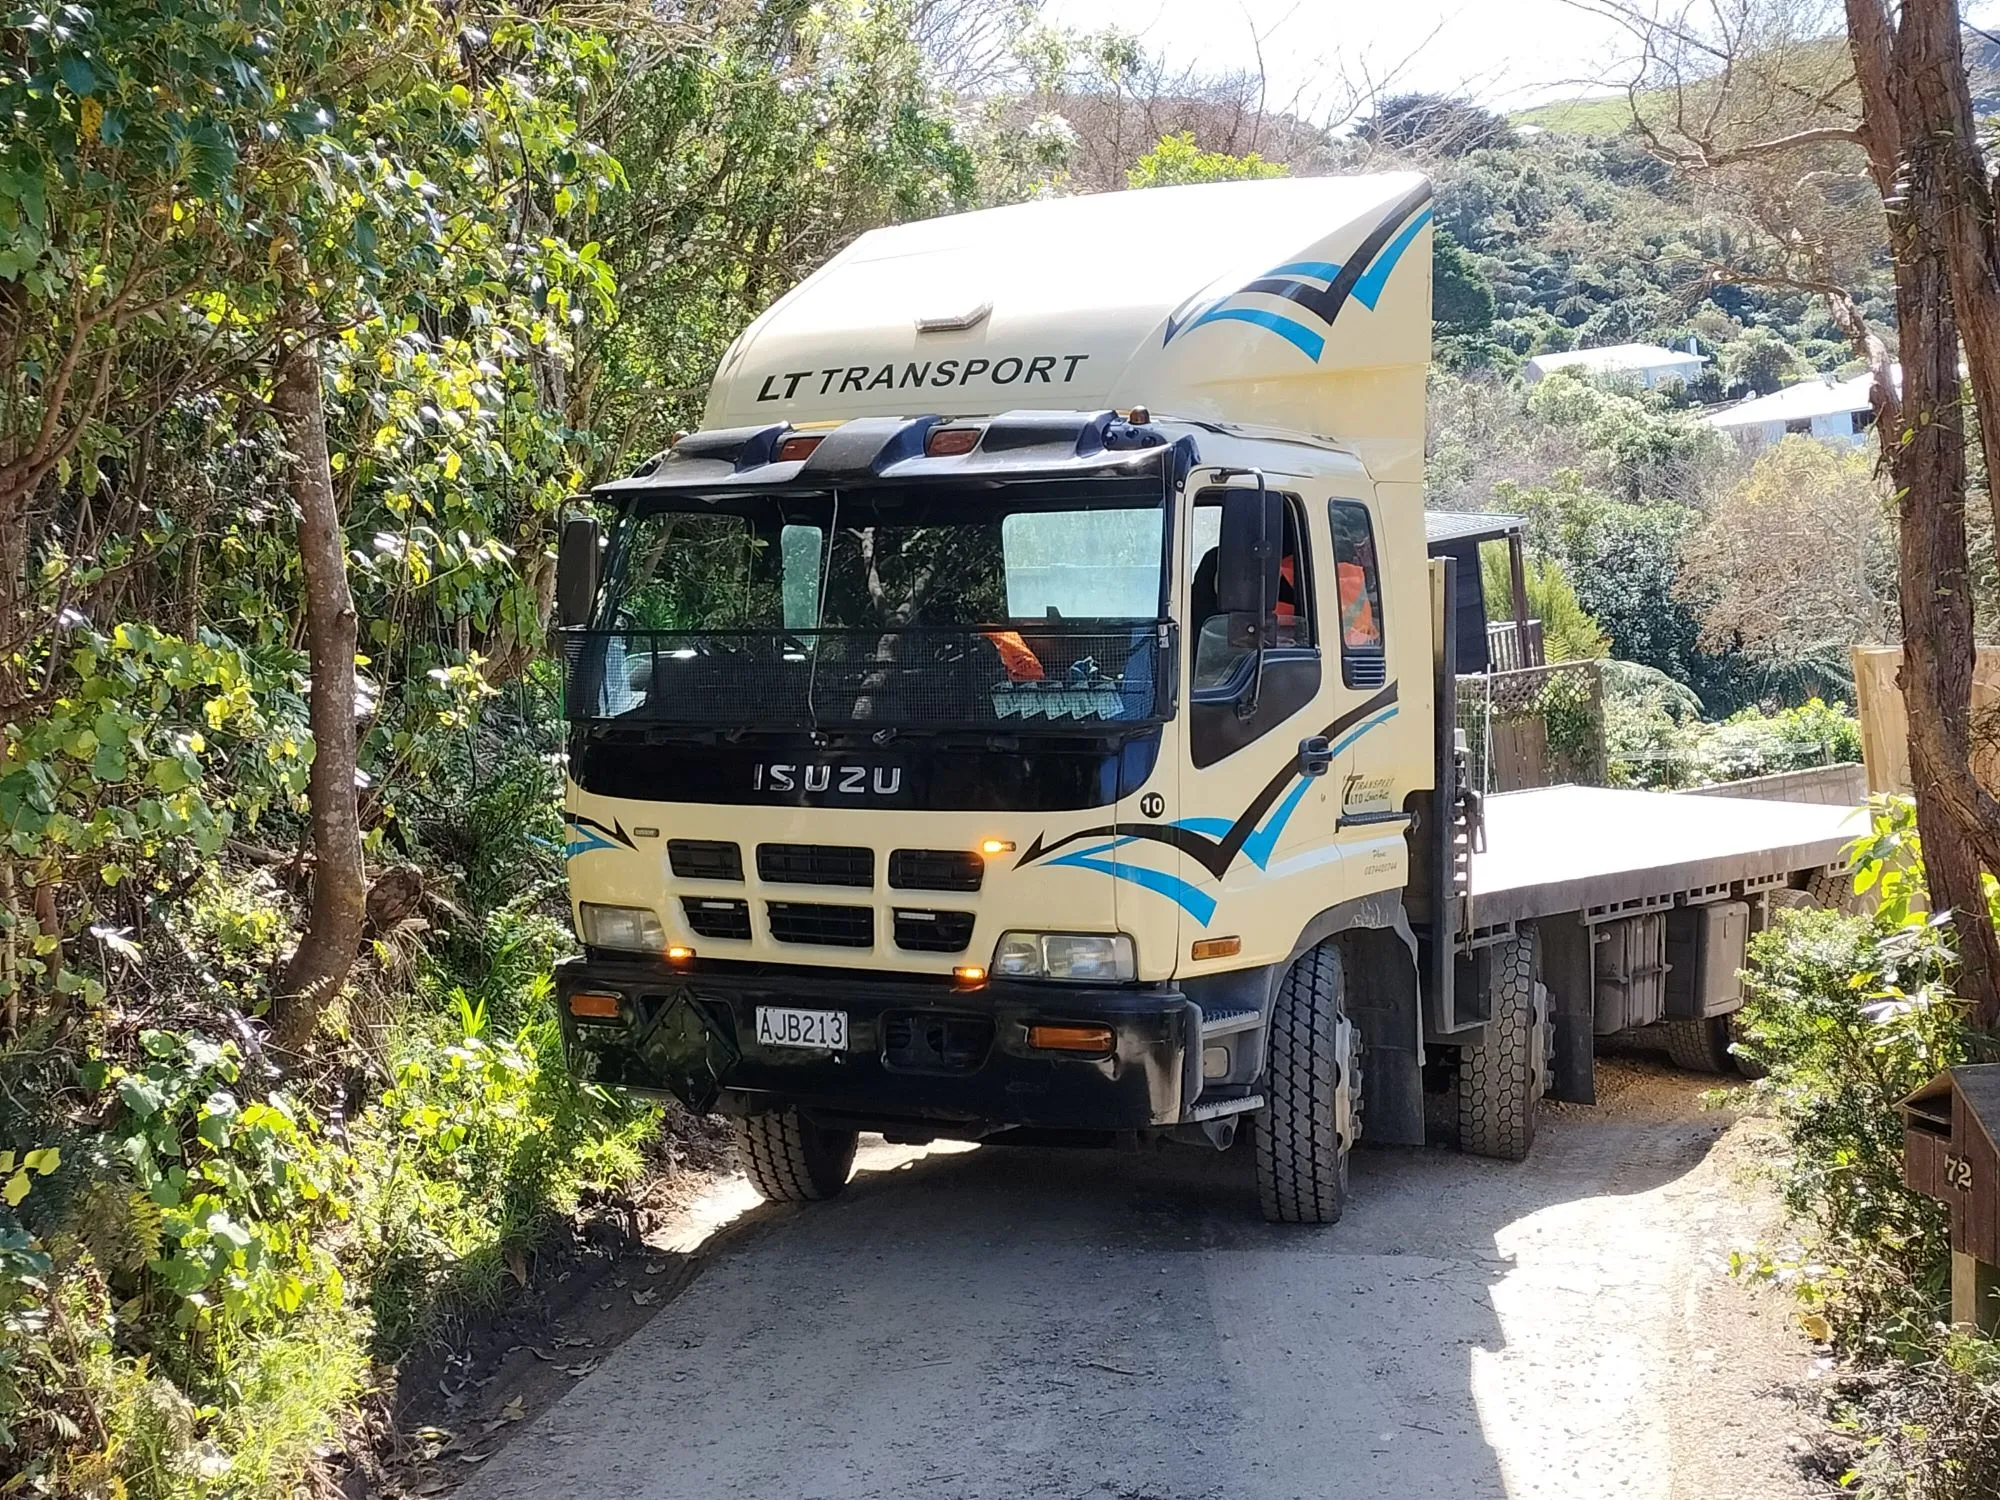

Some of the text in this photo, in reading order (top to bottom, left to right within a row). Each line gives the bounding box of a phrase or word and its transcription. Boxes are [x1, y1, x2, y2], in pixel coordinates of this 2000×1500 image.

[757, 354, 1089, 402] LT TRANSPORT
[753, 764, 901, 795] ISUZU
[1142, 797, 1163, 813] 10
[761, 1012, 842, 1045] AJB213
[1944, 1154, 1972, 1188] 72
